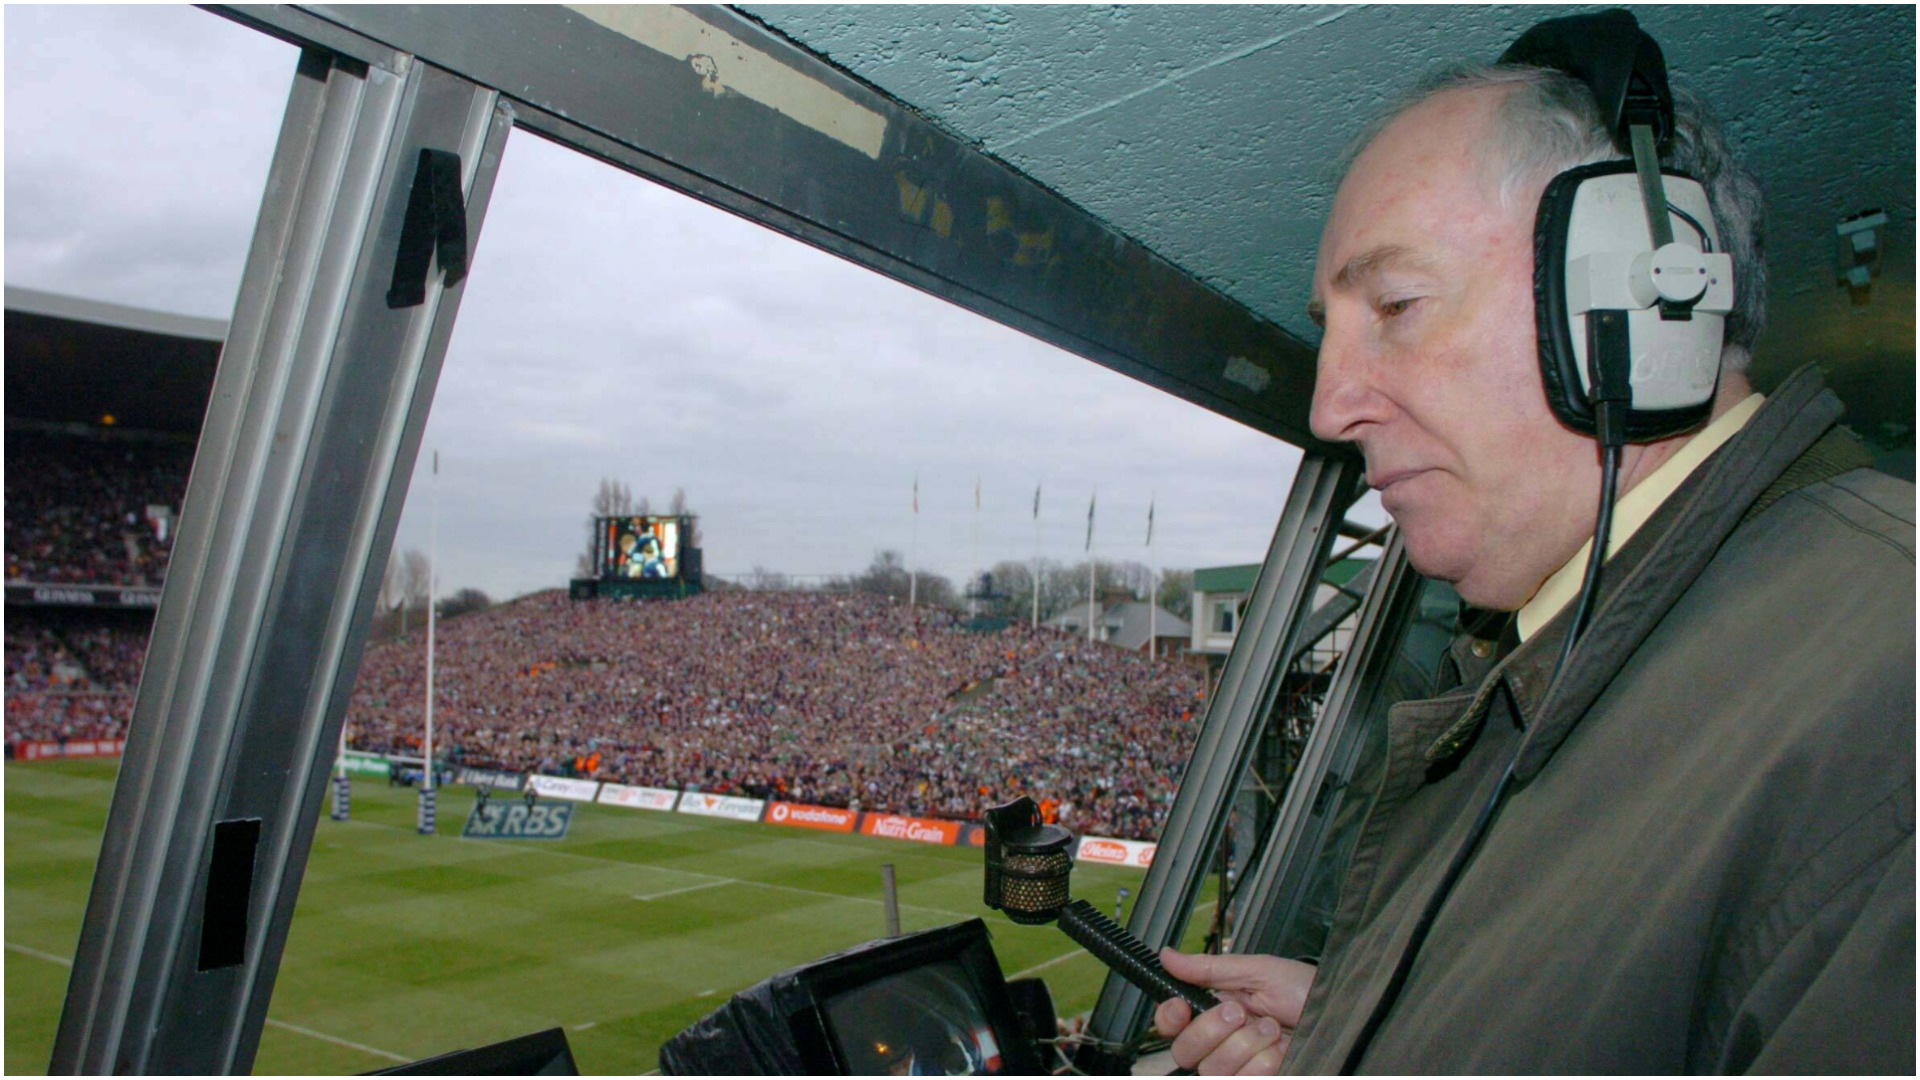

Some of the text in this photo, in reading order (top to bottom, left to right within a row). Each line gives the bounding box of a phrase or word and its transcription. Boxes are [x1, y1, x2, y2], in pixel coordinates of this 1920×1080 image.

[502, 805, 569, 835] RBS
[791, 808, 847, 825] vodafone
[872, 818, 944, 843] Nutri-Grain
